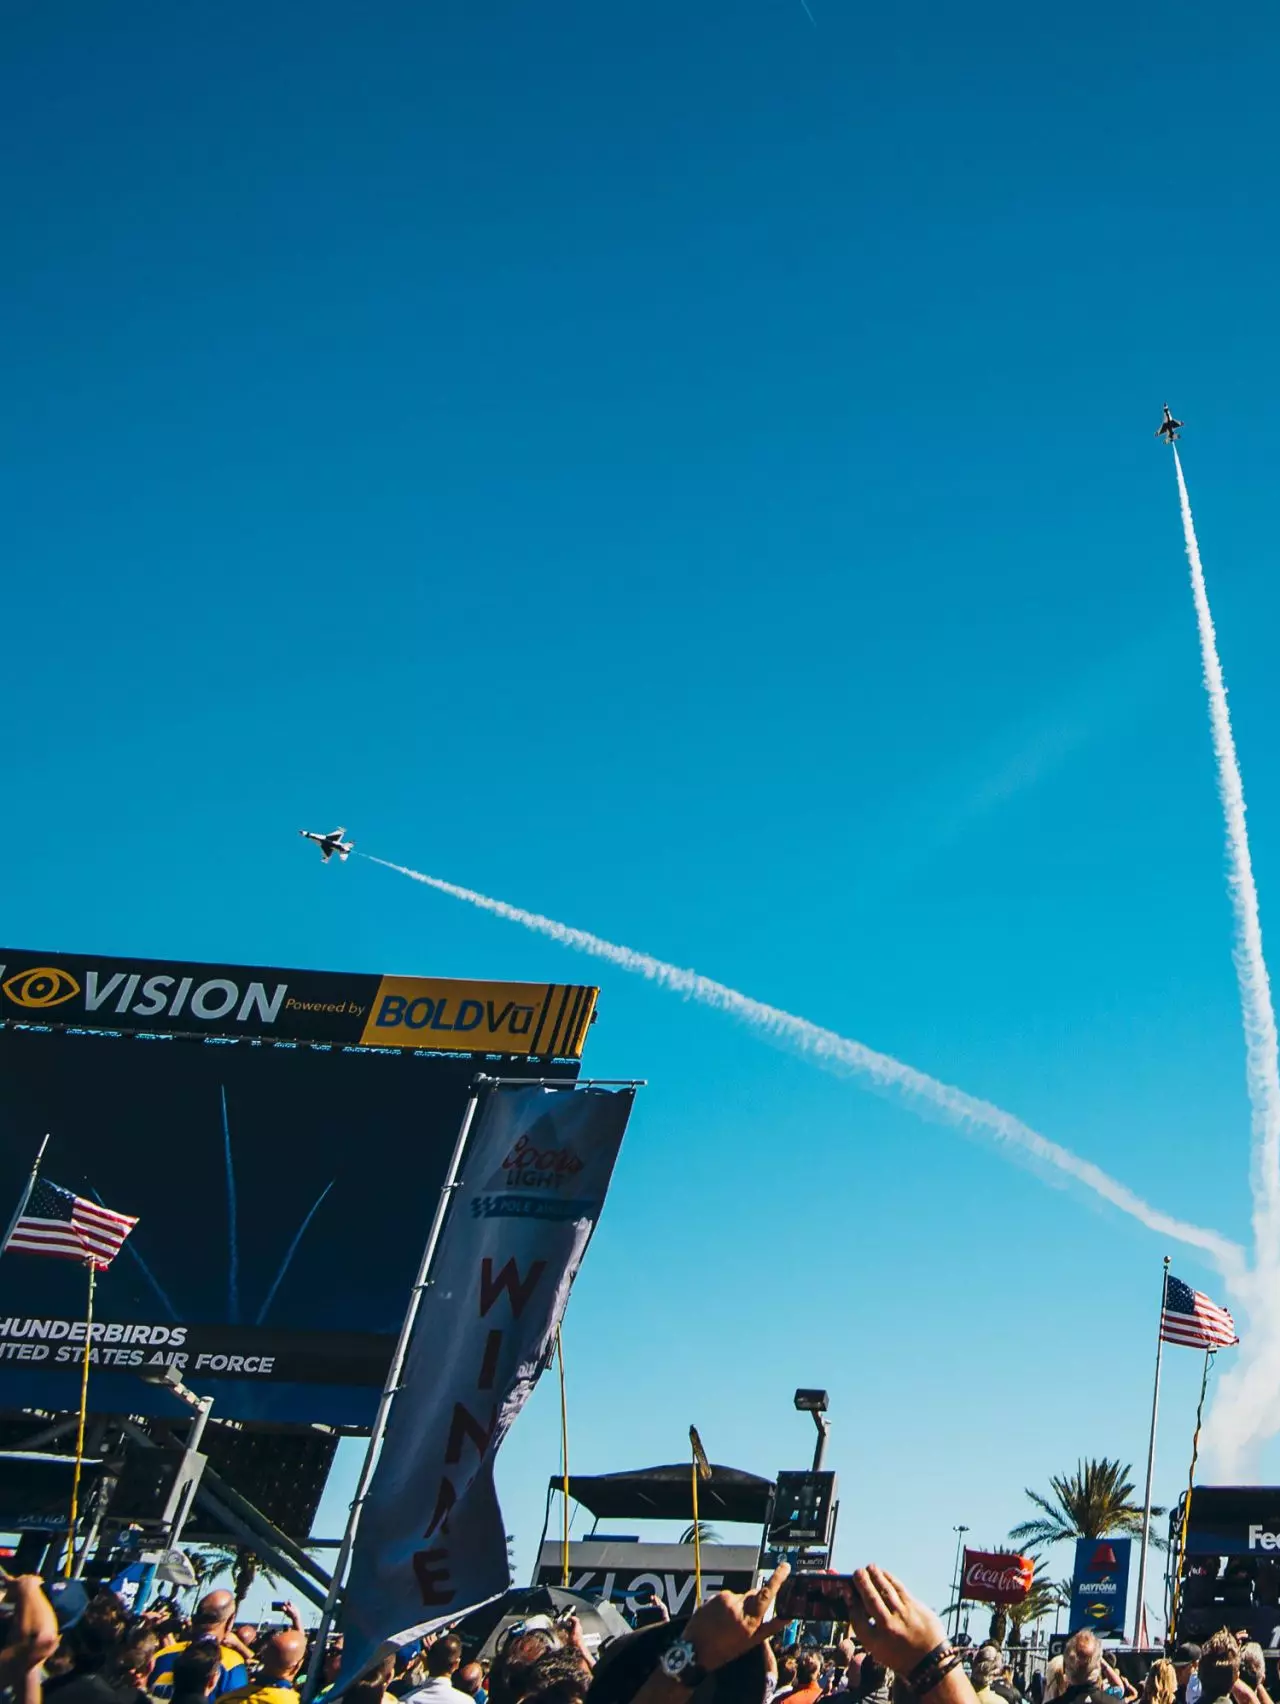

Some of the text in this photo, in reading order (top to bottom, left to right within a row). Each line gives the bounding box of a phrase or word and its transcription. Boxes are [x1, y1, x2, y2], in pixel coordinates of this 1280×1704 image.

[84, 971, 288, 1023] VISION
[284, 998, 366, 1016] Powered by
[505, 1169, 567, 1188] LIGHT
[55, 1346, 143, 1366] STATES
[149, 1350, 189, 1369] AIR
[195, 1354, 275, 1373] FORCE
[1079, 1583, 1117, 1592] DAYTONA
